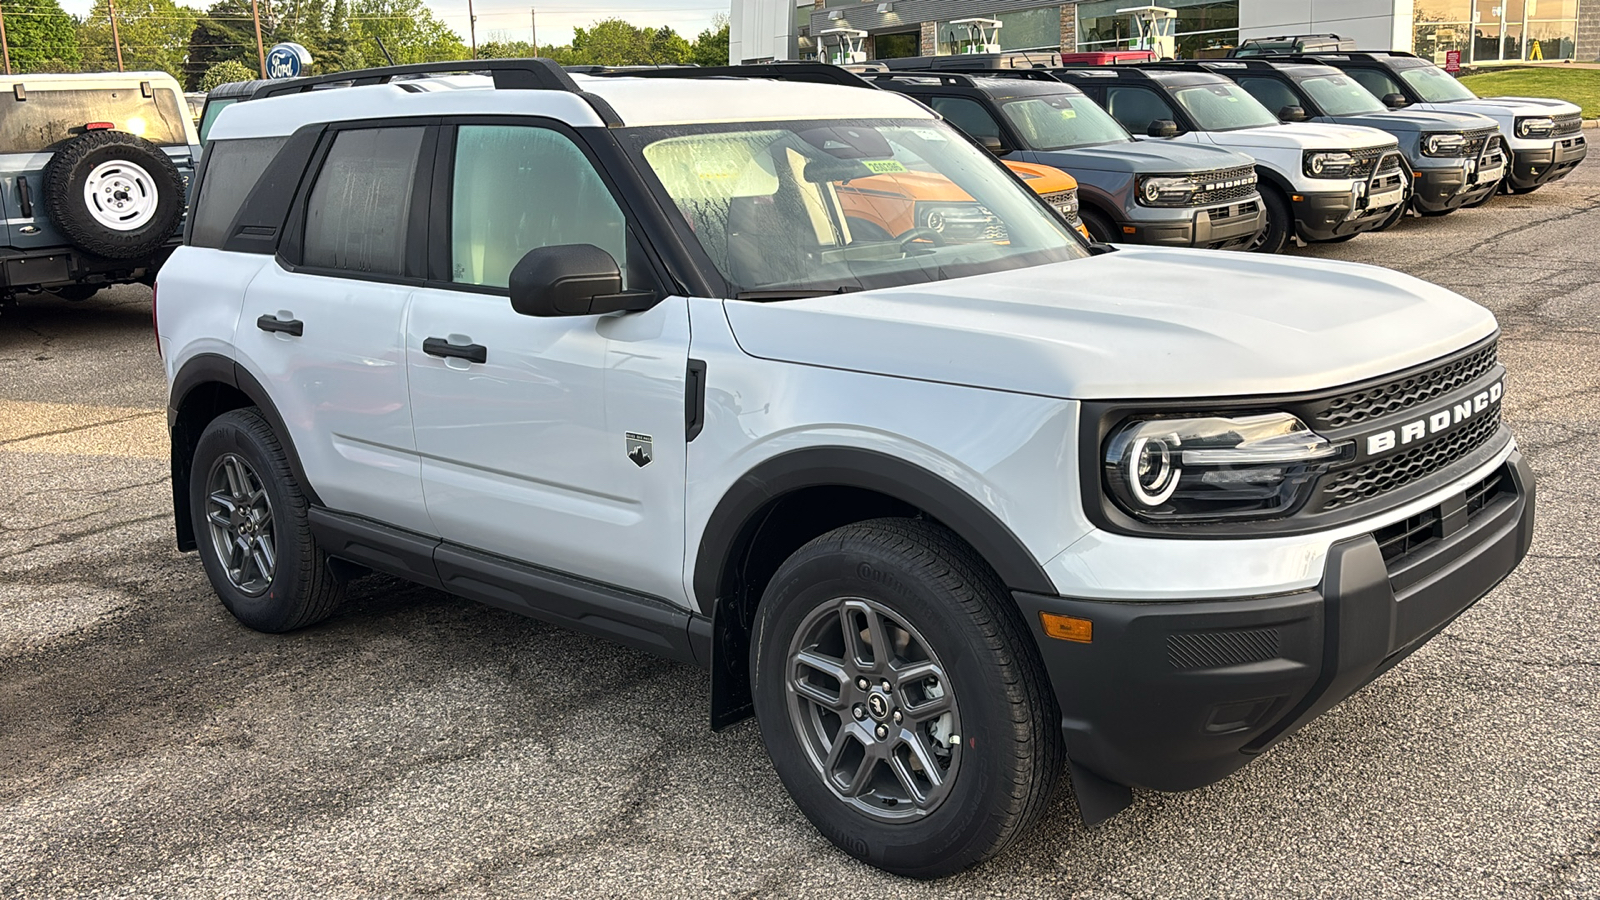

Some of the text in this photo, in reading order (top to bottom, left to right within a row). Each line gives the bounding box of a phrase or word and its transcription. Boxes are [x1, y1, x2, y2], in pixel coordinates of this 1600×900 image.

[271, 53, 293, 77] Ford
[1205, 177, 1254, 191] BRONCO
[1367, 382, 1502, 455] BRONCO
